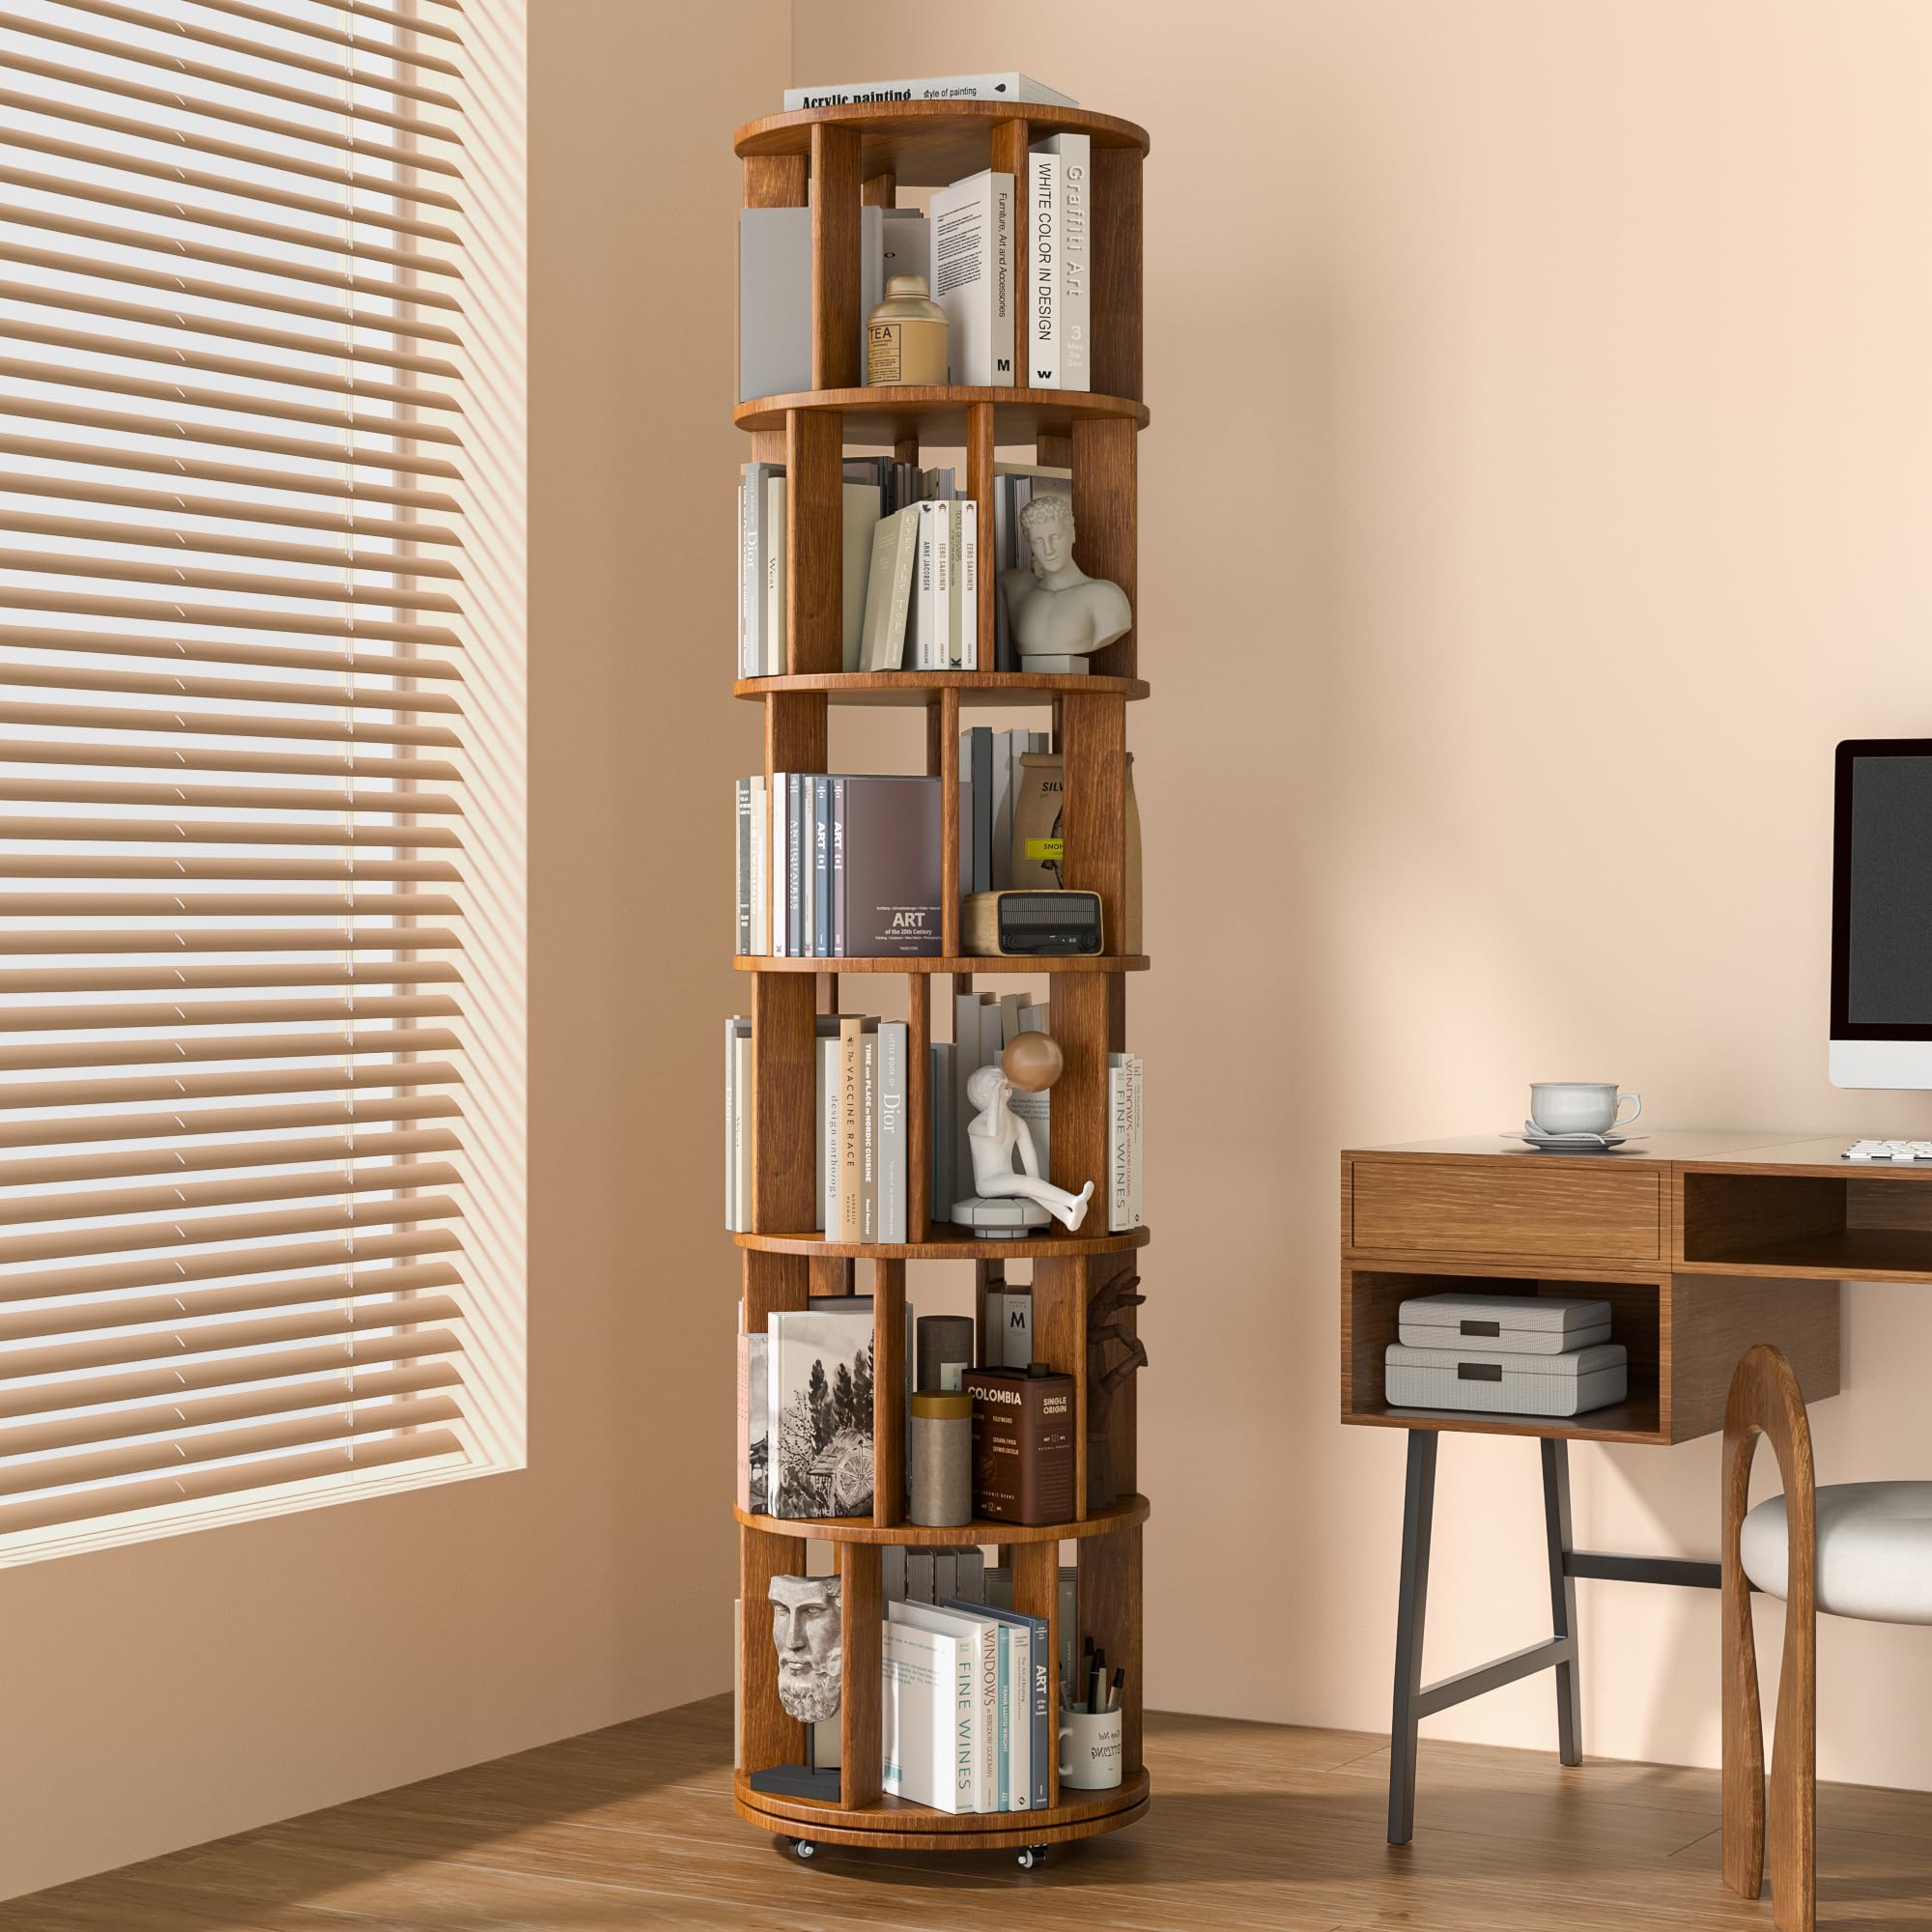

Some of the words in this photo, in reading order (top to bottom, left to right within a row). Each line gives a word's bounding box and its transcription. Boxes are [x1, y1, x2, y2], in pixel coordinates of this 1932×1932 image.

[803, 93, 848, 109] Acrylic
[854, 89, 911, 103] painting
[923, 89, 940, 99] style
[941, 88, 949, 97] of
[950, 86, 977, 98] painting
[1038, 163, 1051, 209] WHITE
[1066, 165, 1084, 251] Graffiti
[1038, 213, 1051, 263] COLOR
[1038, 268, 1051, 282] IN
[1066, 261, 1084, 296] Art
[1038, 286, 1051, 340] DESIGN
[870, 327, 892, 340] TEA
[997, 358, 1010, 371] M
[747, 530, 757, 571] Dior
[817, 821, 826, 850] ART
[834, 821, 842, 850] ART
[892, 912, 925, 927] ART
[846, 1066, 855, 1125] VACCINE
[882, 1092, 901, 1134] Dior
[1117, 1091, 1125, 1133] FINE
[829, 1095, 838, 1135] design
[846, 1133, 855, 1167] RACE
[829, 1139, 838, 1200] anthology
[1117, 1143, 1125, 1208] WINES
[1010, 1311, 1026, 1328] M
[968, 1386, 1022, 1406] COLOMBIA
[1043, 1396, 1066, 1406] SINGLE
[1043, 1405, 1066, 1414] ORIGIN
[983, 1629, 996, 1706] WINDOWS
[1036, 1664, 1047, 1694] ART
[958, 1662, 971, 1710] FINE
[958, 1719, 971, 1790] WINES
